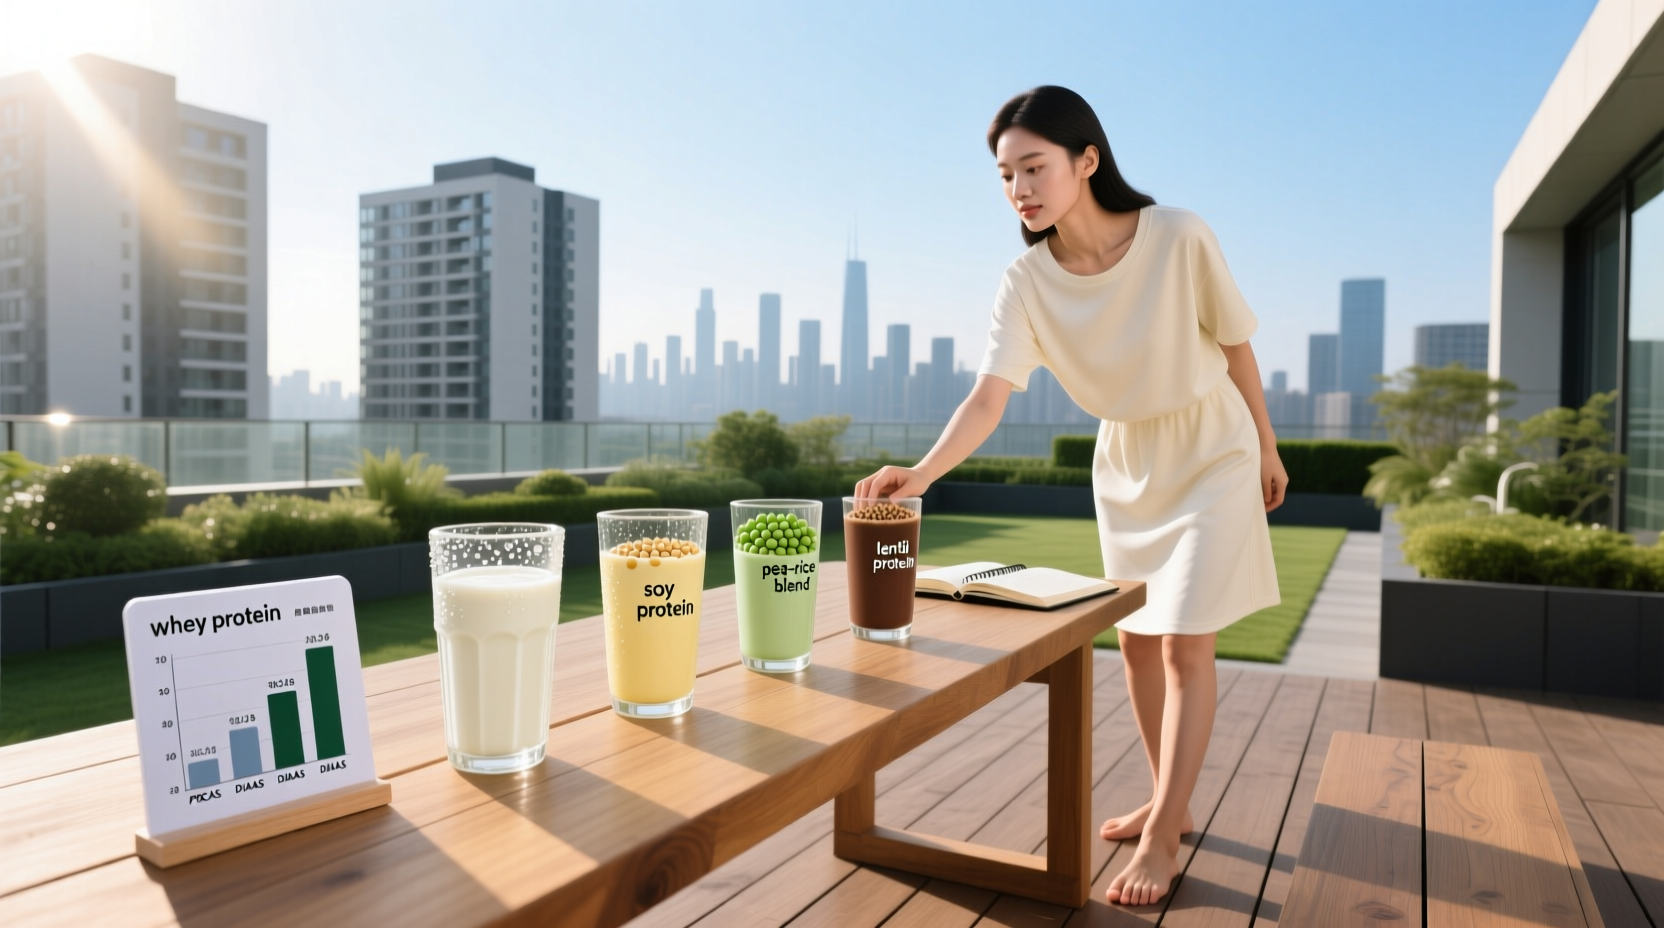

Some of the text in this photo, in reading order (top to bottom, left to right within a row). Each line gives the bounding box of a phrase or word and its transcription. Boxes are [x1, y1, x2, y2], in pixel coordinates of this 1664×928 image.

[876, 540, 909, 556] lentil
[762, 560, 816, 580] pea-rice
[873, 557, 915, 573] protein
[644, 583, 675, 601] soy
[774, 577, 811, 593] blend
[637, 599, 694, 622] protein
[150, 615, 207, 637] whey
[212, 604, 281, 633] protein
